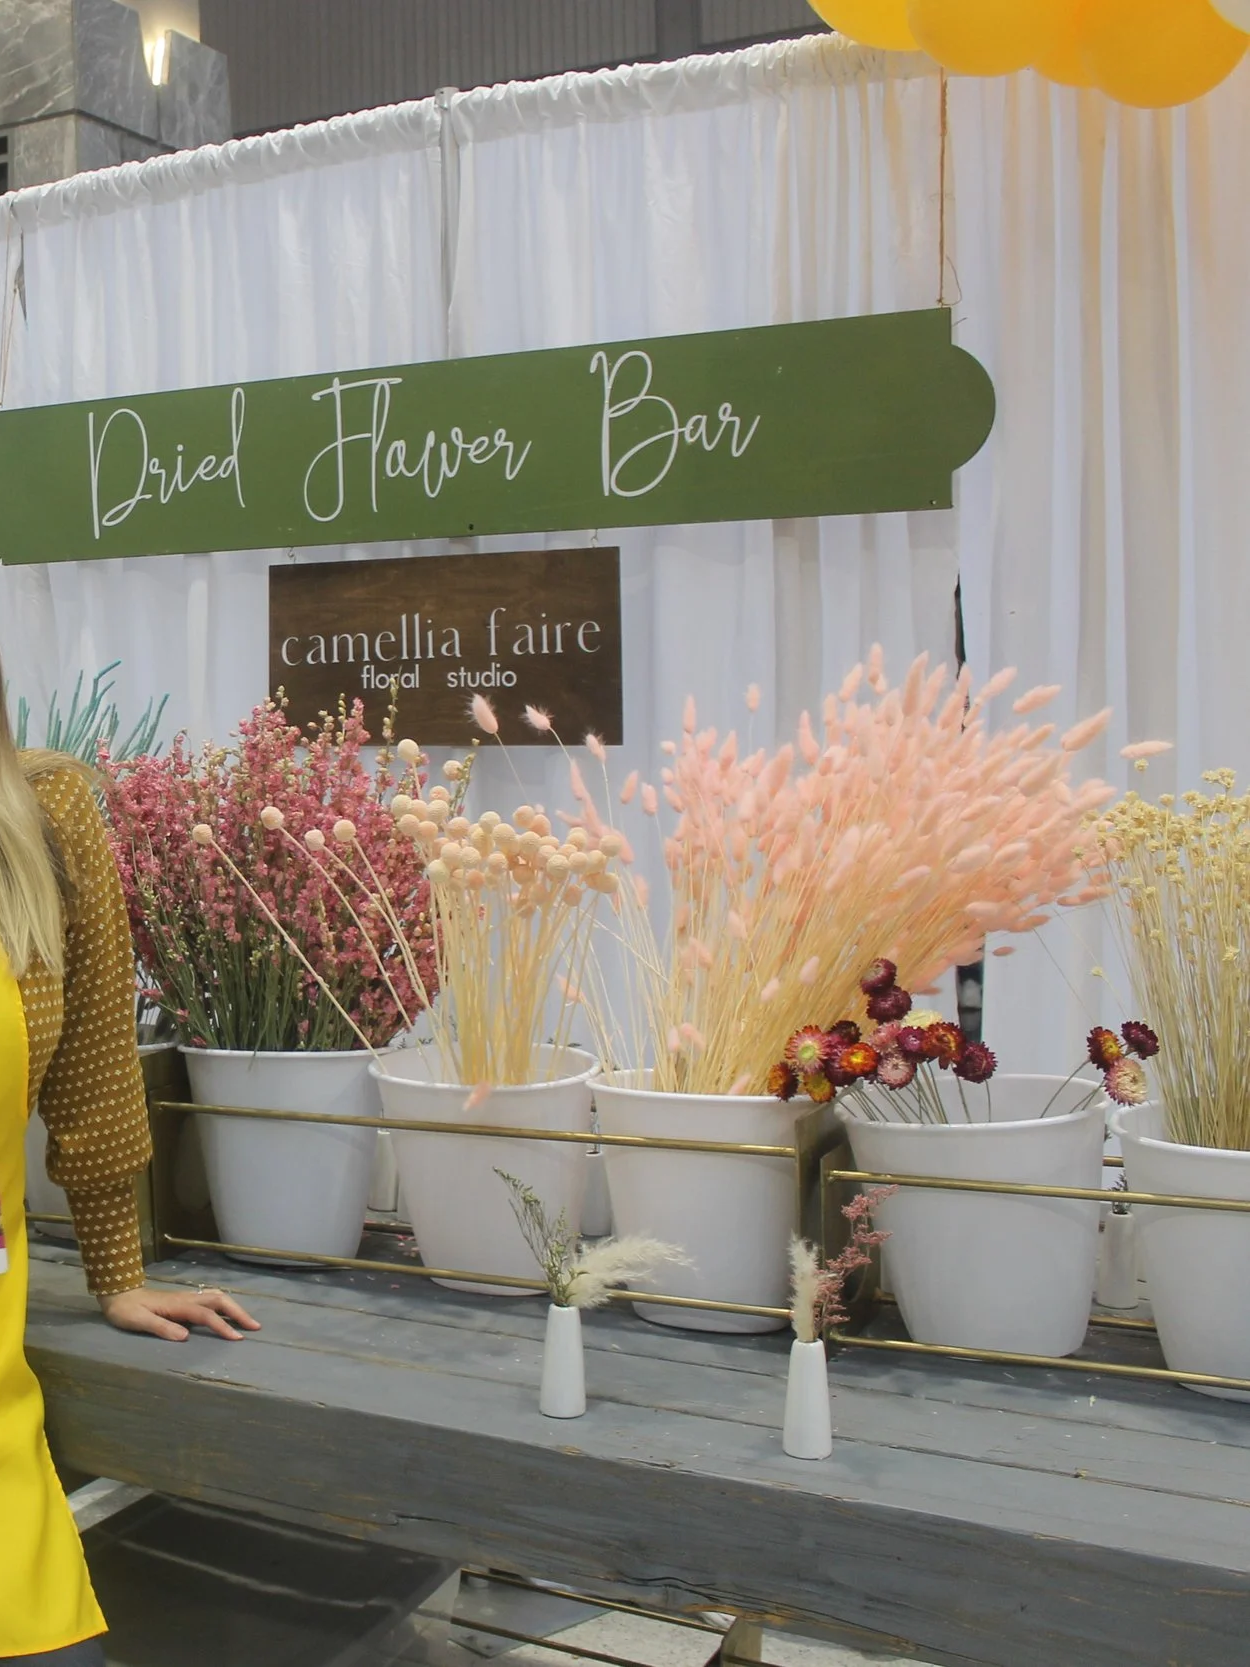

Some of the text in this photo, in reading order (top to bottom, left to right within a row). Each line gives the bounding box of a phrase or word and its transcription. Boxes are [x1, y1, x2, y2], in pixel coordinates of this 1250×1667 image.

[88, 350, 761, 540] Dried Flower Bar
[281, 607, 601, 667] camellia faire
[447, 663, 517, 688] studio
